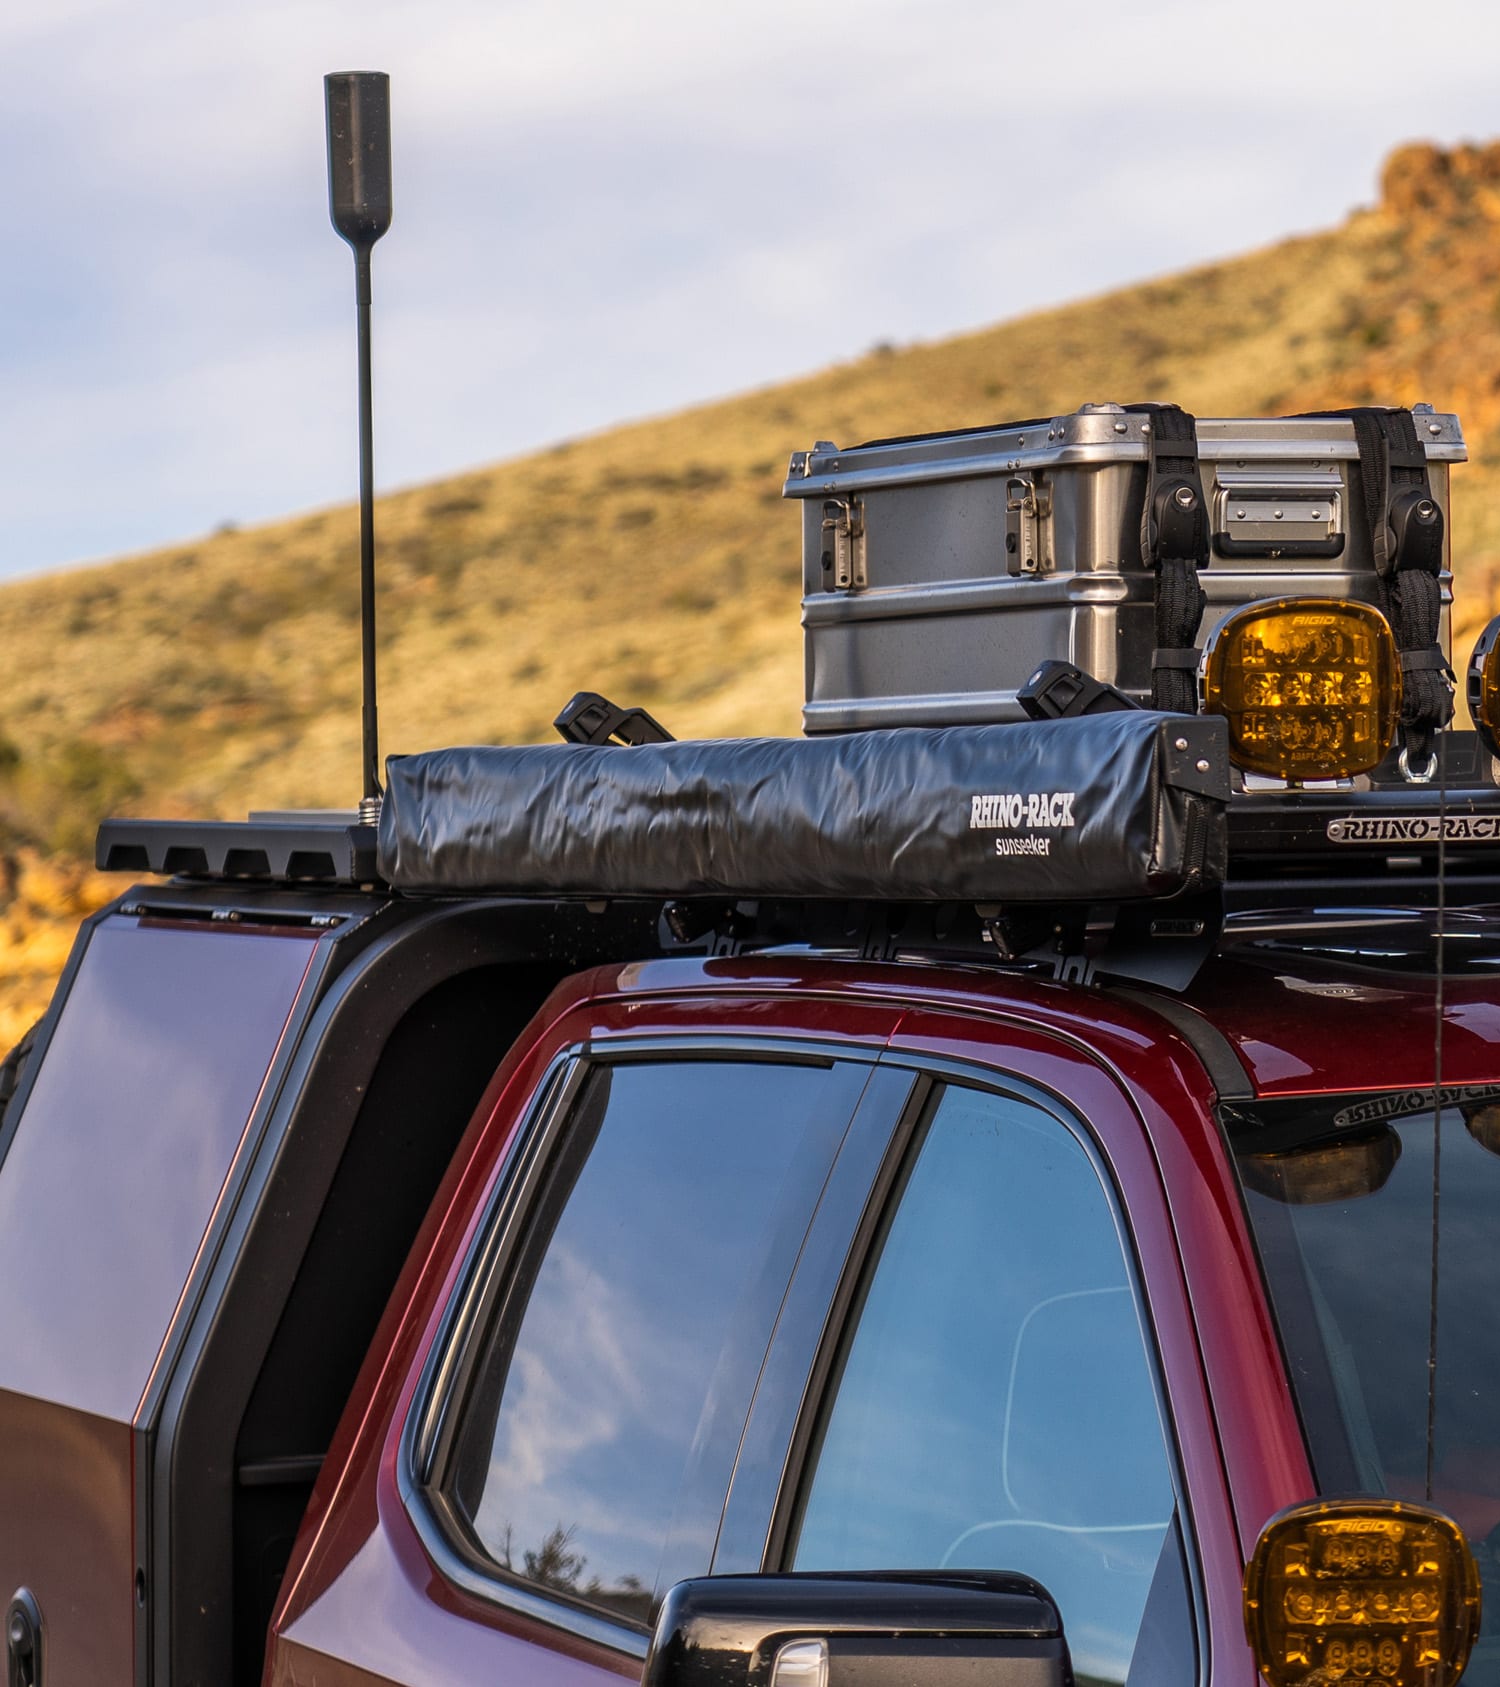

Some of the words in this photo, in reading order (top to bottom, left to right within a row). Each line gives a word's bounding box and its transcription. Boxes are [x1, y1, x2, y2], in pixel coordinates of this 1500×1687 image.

[1291, 615, 1337, 625] RIGID
[969, 792, 1075, 829] RHINO-RACK
[995, 833, 1051, 857] sunseeker
[1335, 1521, 1389, 1533] RIGID
